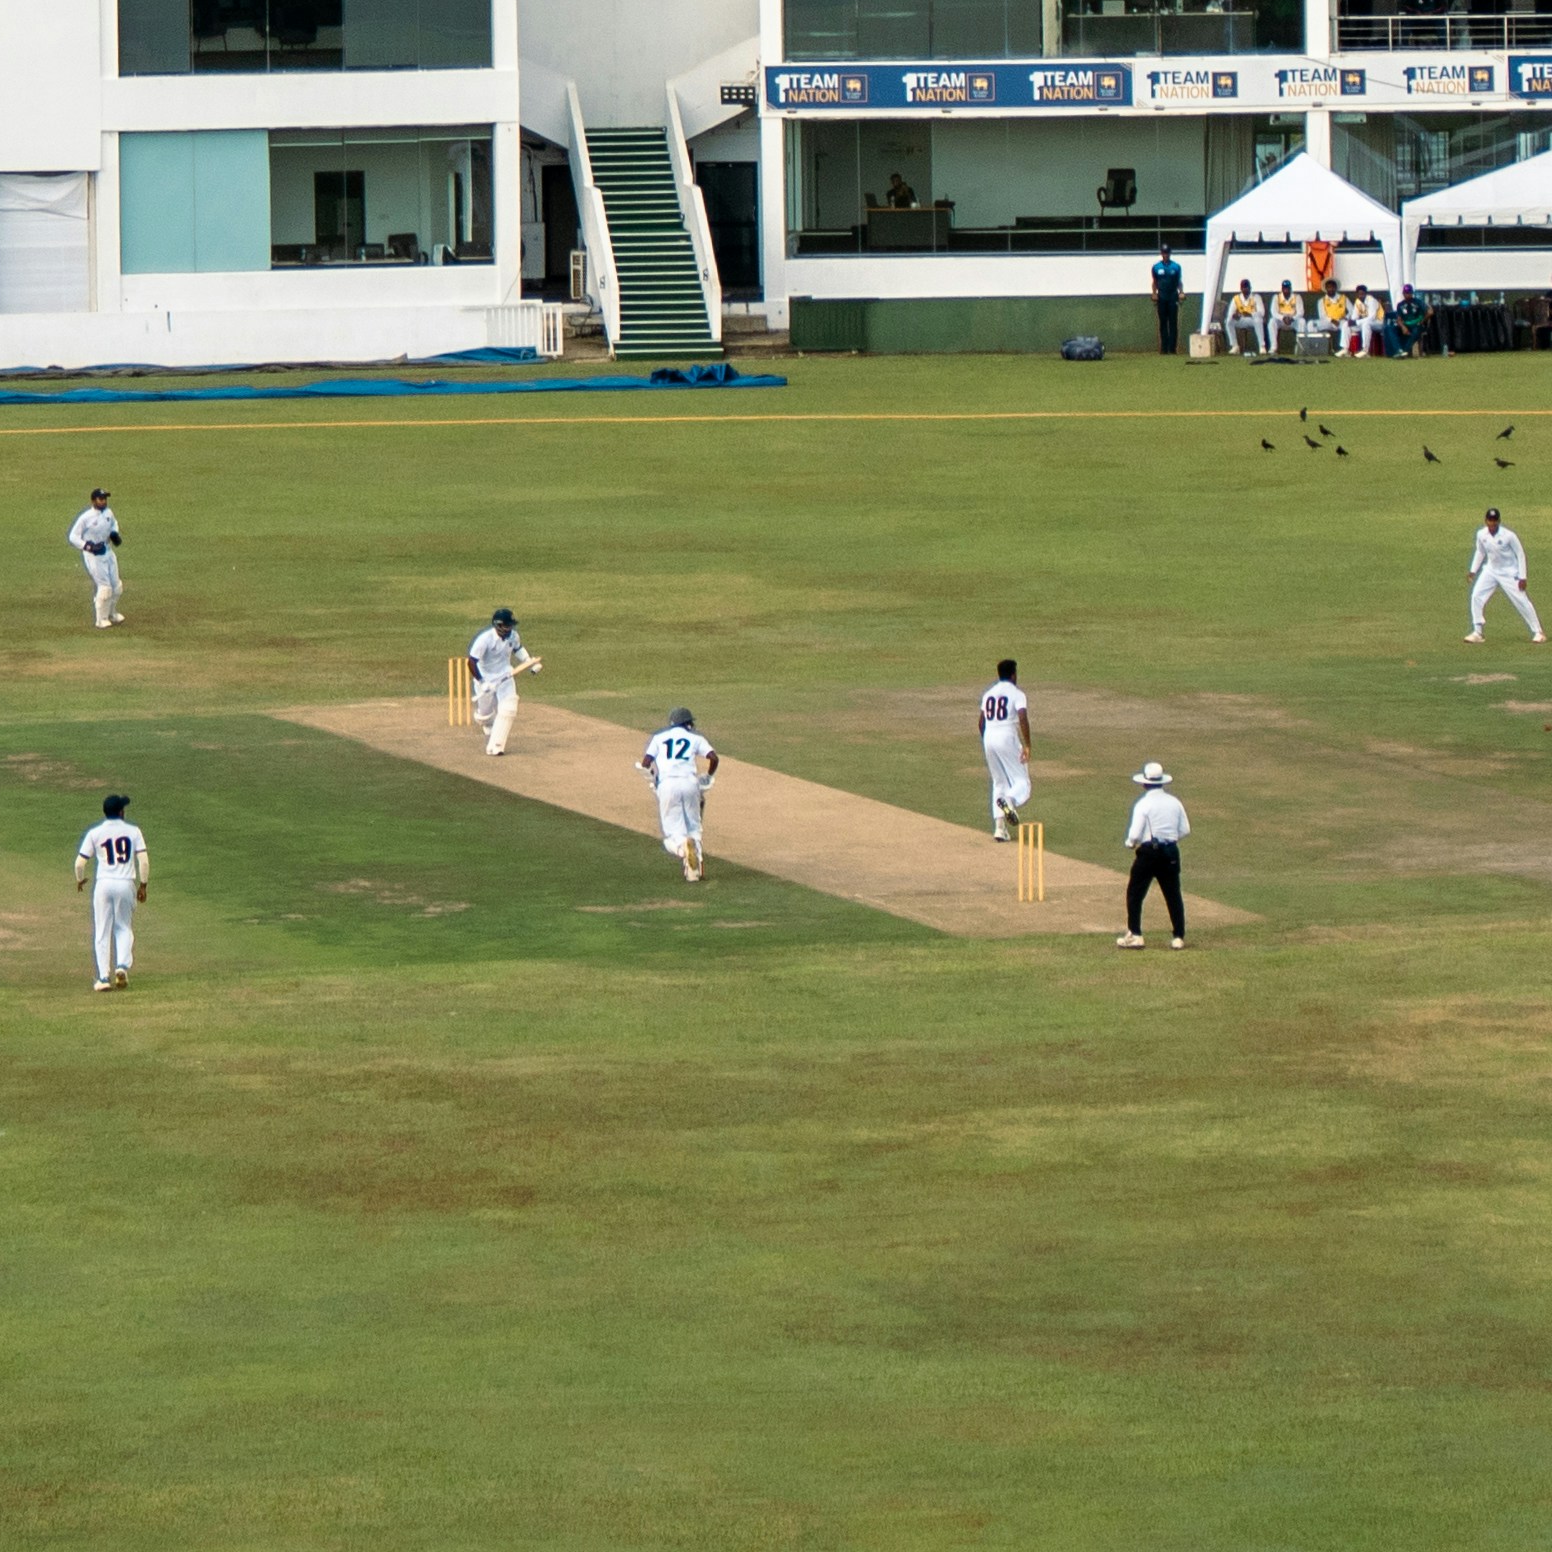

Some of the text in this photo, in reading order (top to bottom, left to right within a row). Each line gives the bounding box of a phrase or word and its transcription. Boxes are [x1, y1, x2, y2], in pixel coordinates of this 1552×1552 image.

[789, 87, 839, 102] NATION
[916, 87, 966, 102] NATION
[1043, 86, 1093, 100] NATION
[1159, 85, 1209, 99] NATION
[1287, 83, 1337, 96] NATION
[1415, 80, 1466, 94] NATION
[985, 695, 1009, 721] 98
[662, 737, 691, 760] 12
[100, 836, 132, 866] 19
